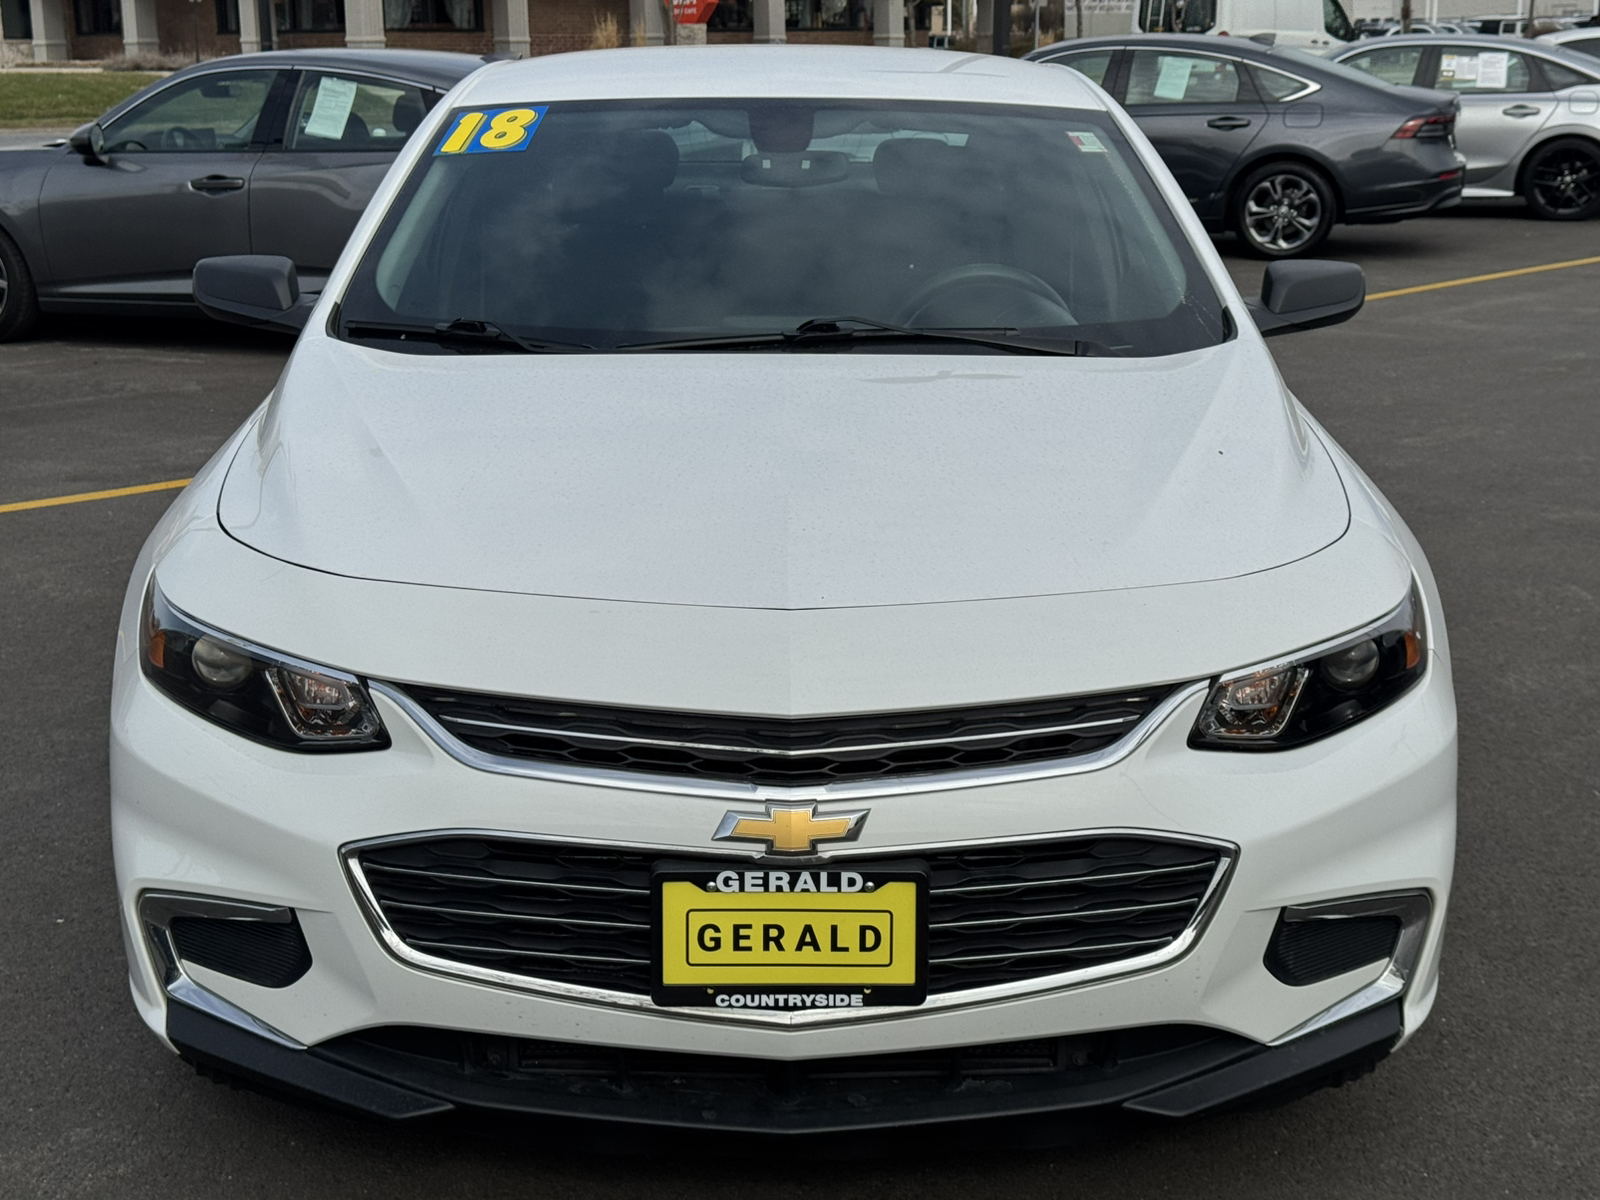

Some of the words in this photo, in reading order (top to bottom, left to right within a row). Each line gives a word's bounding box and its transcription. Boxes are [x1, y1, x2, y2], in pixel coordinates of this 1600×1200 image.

[440, 108, 538, 153] 18
[716, 870, 864, 893] GERALD
[697, 923, 882, 952] GERALD
[715, 994, 863, 1007] COUNTRYSIDE
